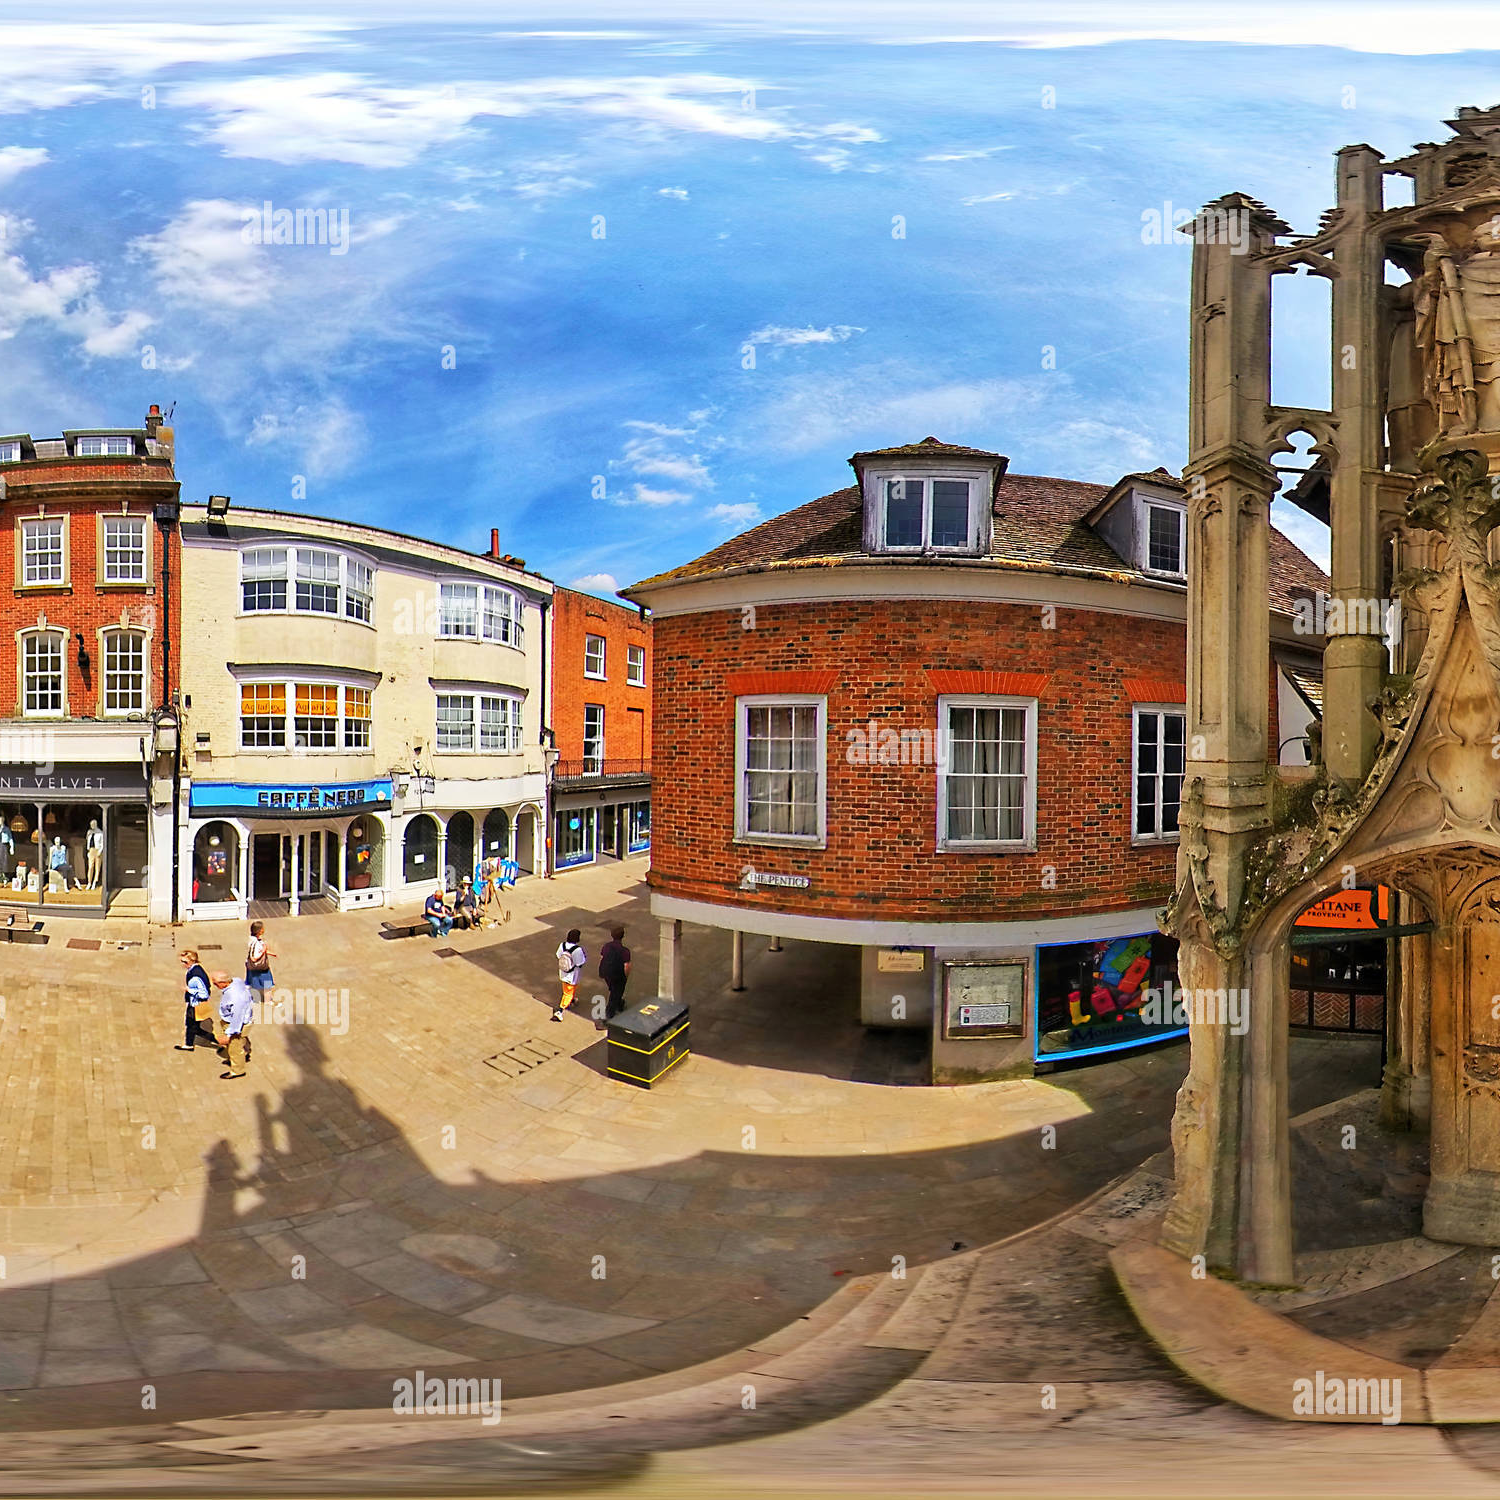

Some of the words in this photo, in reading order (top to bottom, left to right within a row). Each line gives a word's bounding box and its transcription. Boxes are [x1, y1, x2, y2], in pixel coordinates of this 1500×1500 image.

[34, 777, 105, 790] VELVET
[324, 789, 365, 804] NERO
[769, 875, 806, 887] PENTICE
